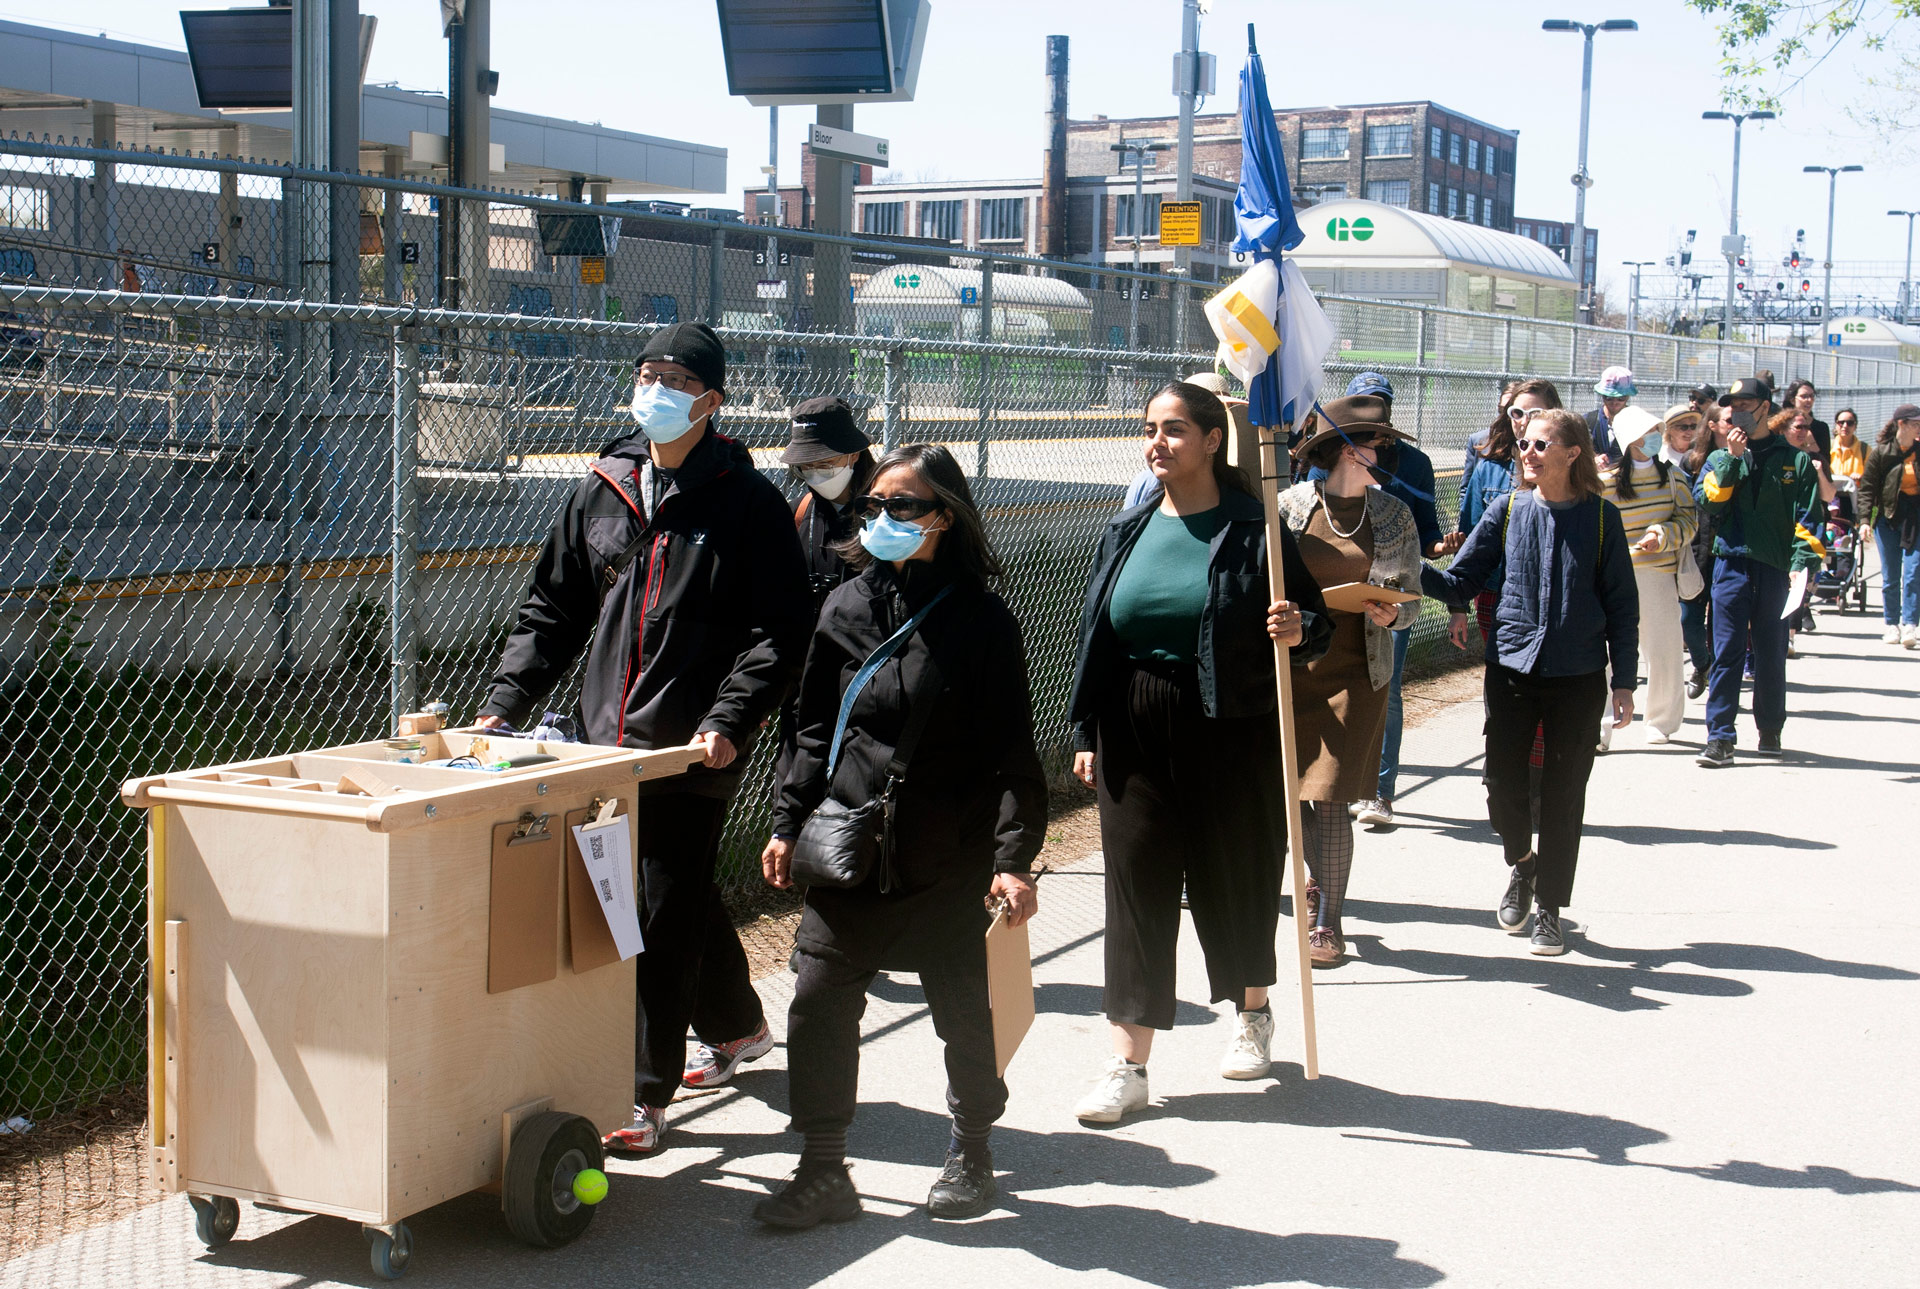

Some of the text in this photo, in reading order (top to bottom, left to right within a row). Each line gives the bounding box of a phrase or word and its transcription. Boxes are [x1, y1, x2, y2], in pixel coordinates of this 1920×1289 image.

[815, 130, 833, 145] Bloor
[1326, 217, 1374, 241] GO
[207, 246, 216, 260] 3
[405, 246, 415, 260] 2
[756, 253, 764, 264] 3
[780, 253, 788, 264] 2
[1559, 248, 1566, 261] 1
[1122, 290, 1129, 299] 3
[1141, 290, 1149, 300] 2
[1813, 307, 1819, 316] 1
